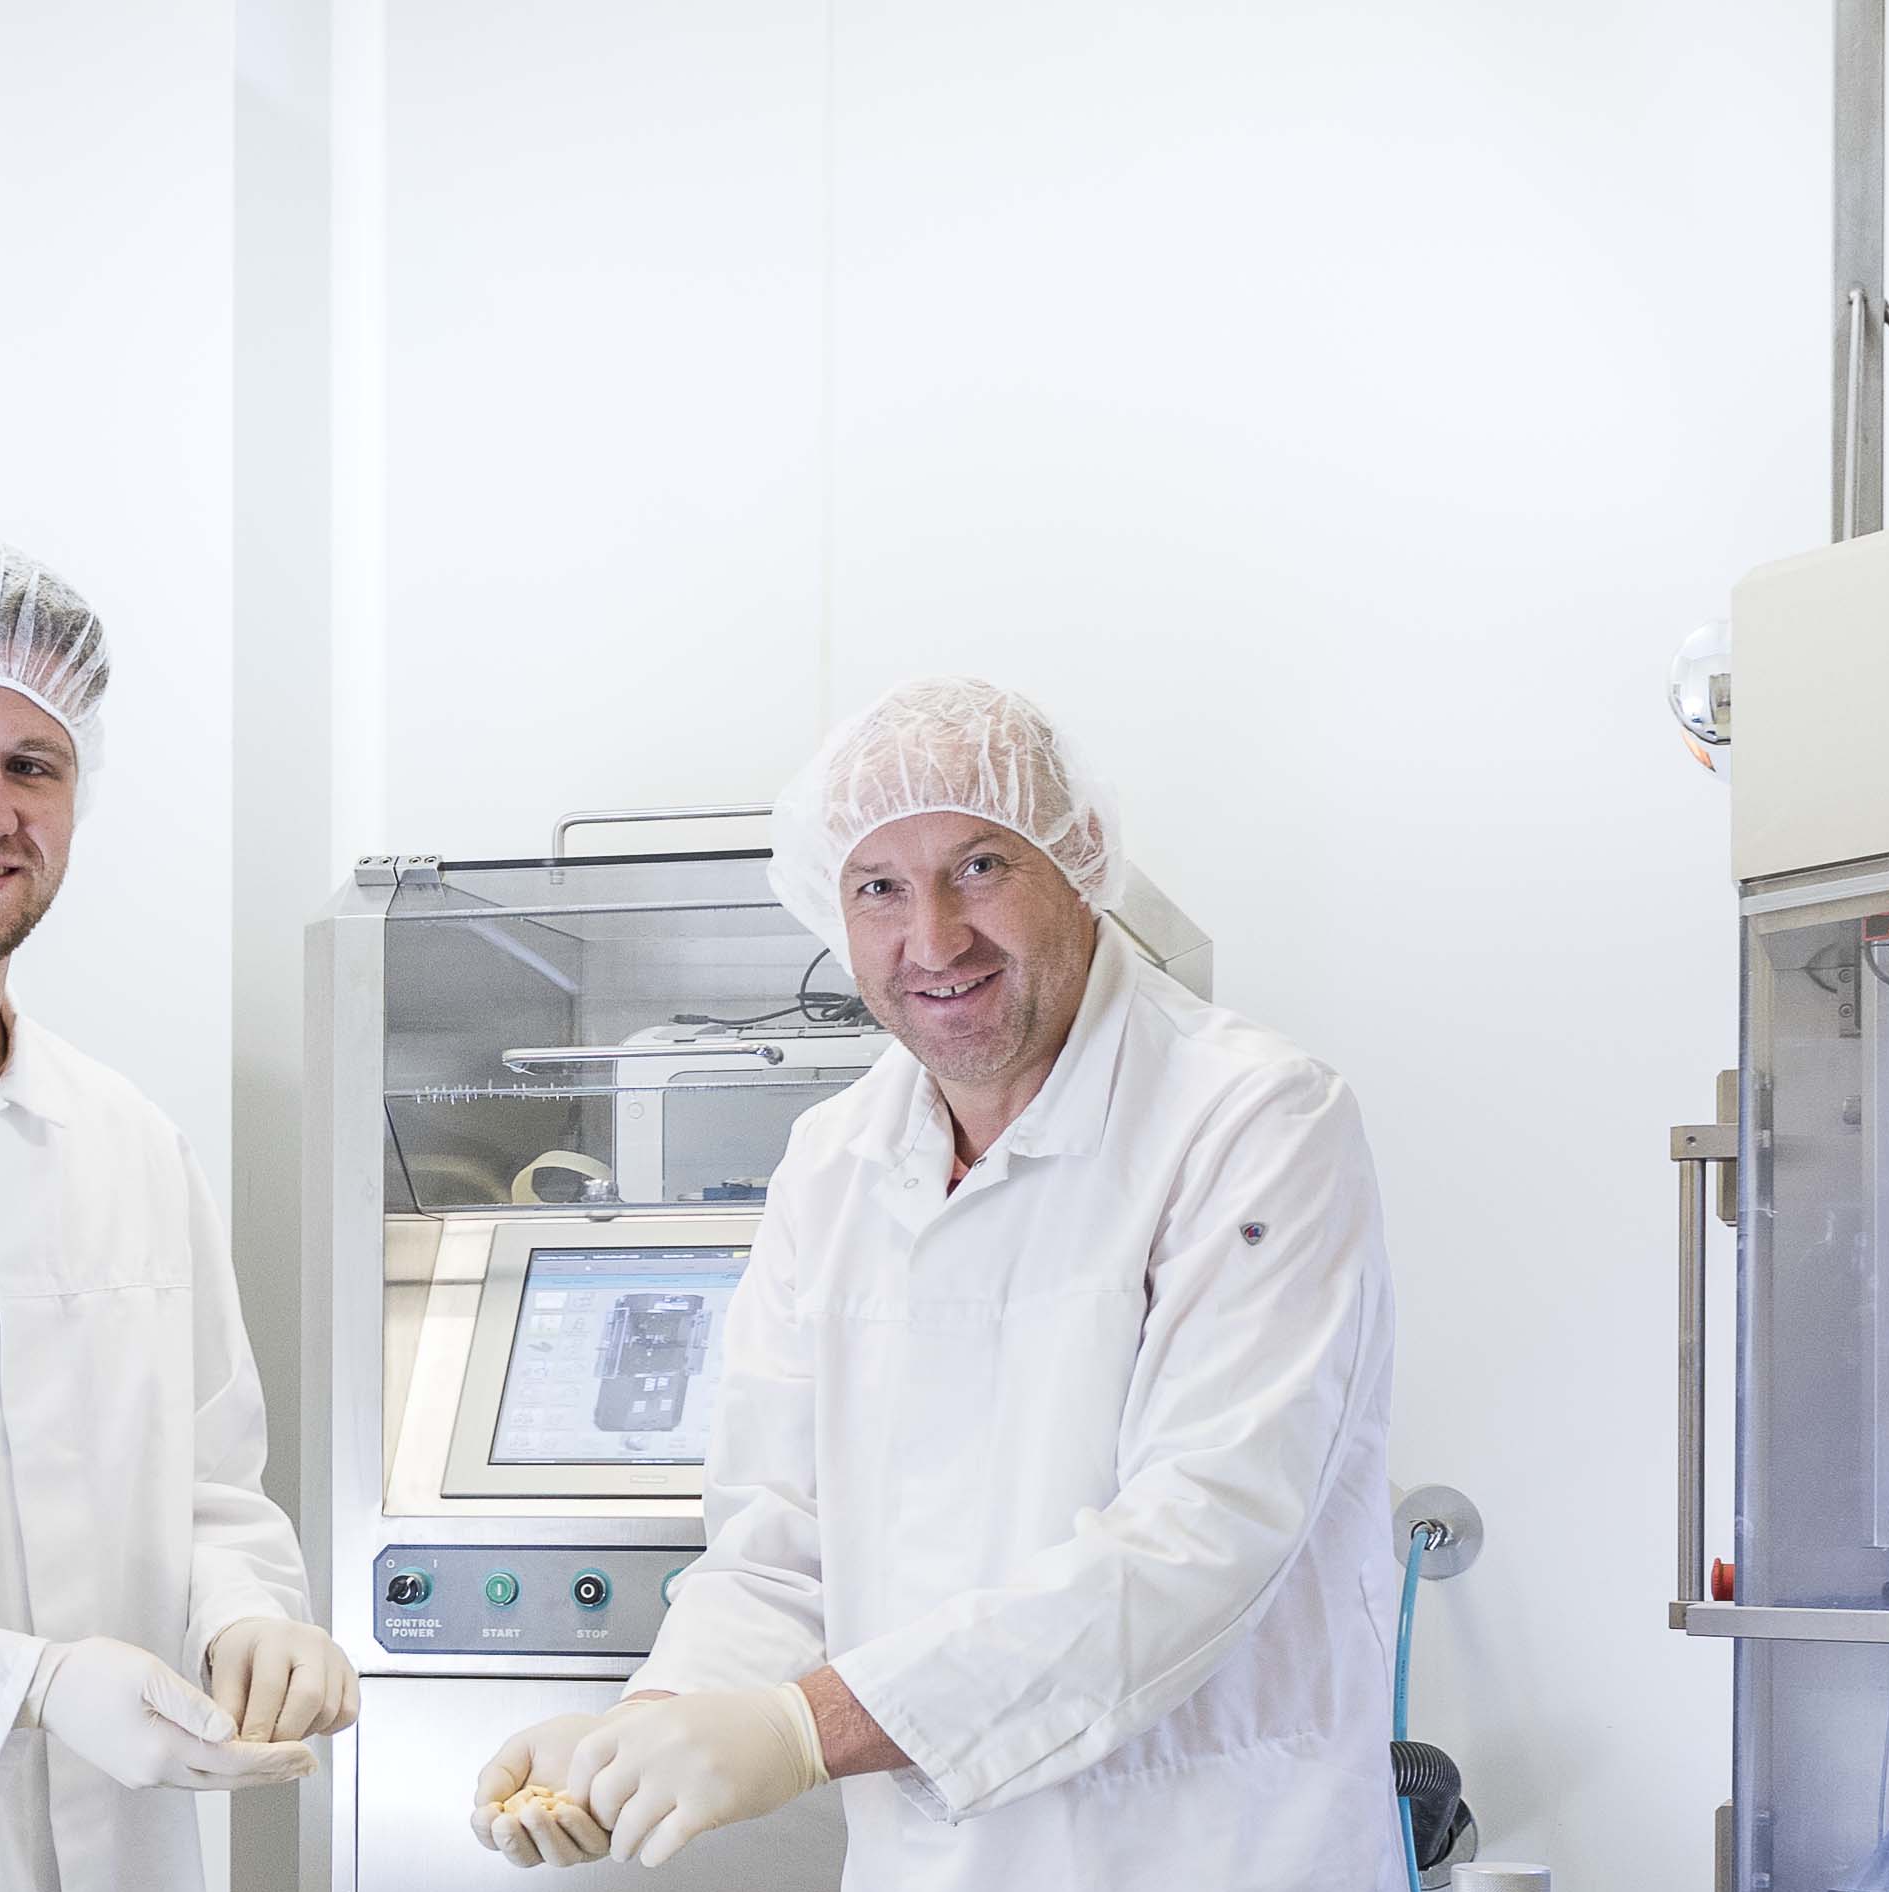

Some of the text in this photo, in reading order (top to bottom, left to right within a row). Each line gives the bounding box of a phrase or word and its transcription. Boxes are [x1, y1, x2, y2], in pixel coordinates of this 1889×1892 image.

[385, 1618, 442, 1628] CONTROL
[392, 1628, 435, 1638] POWER
[482, 1629, 521, 1638] START
[576, 1629, 609, 1639] STOP
